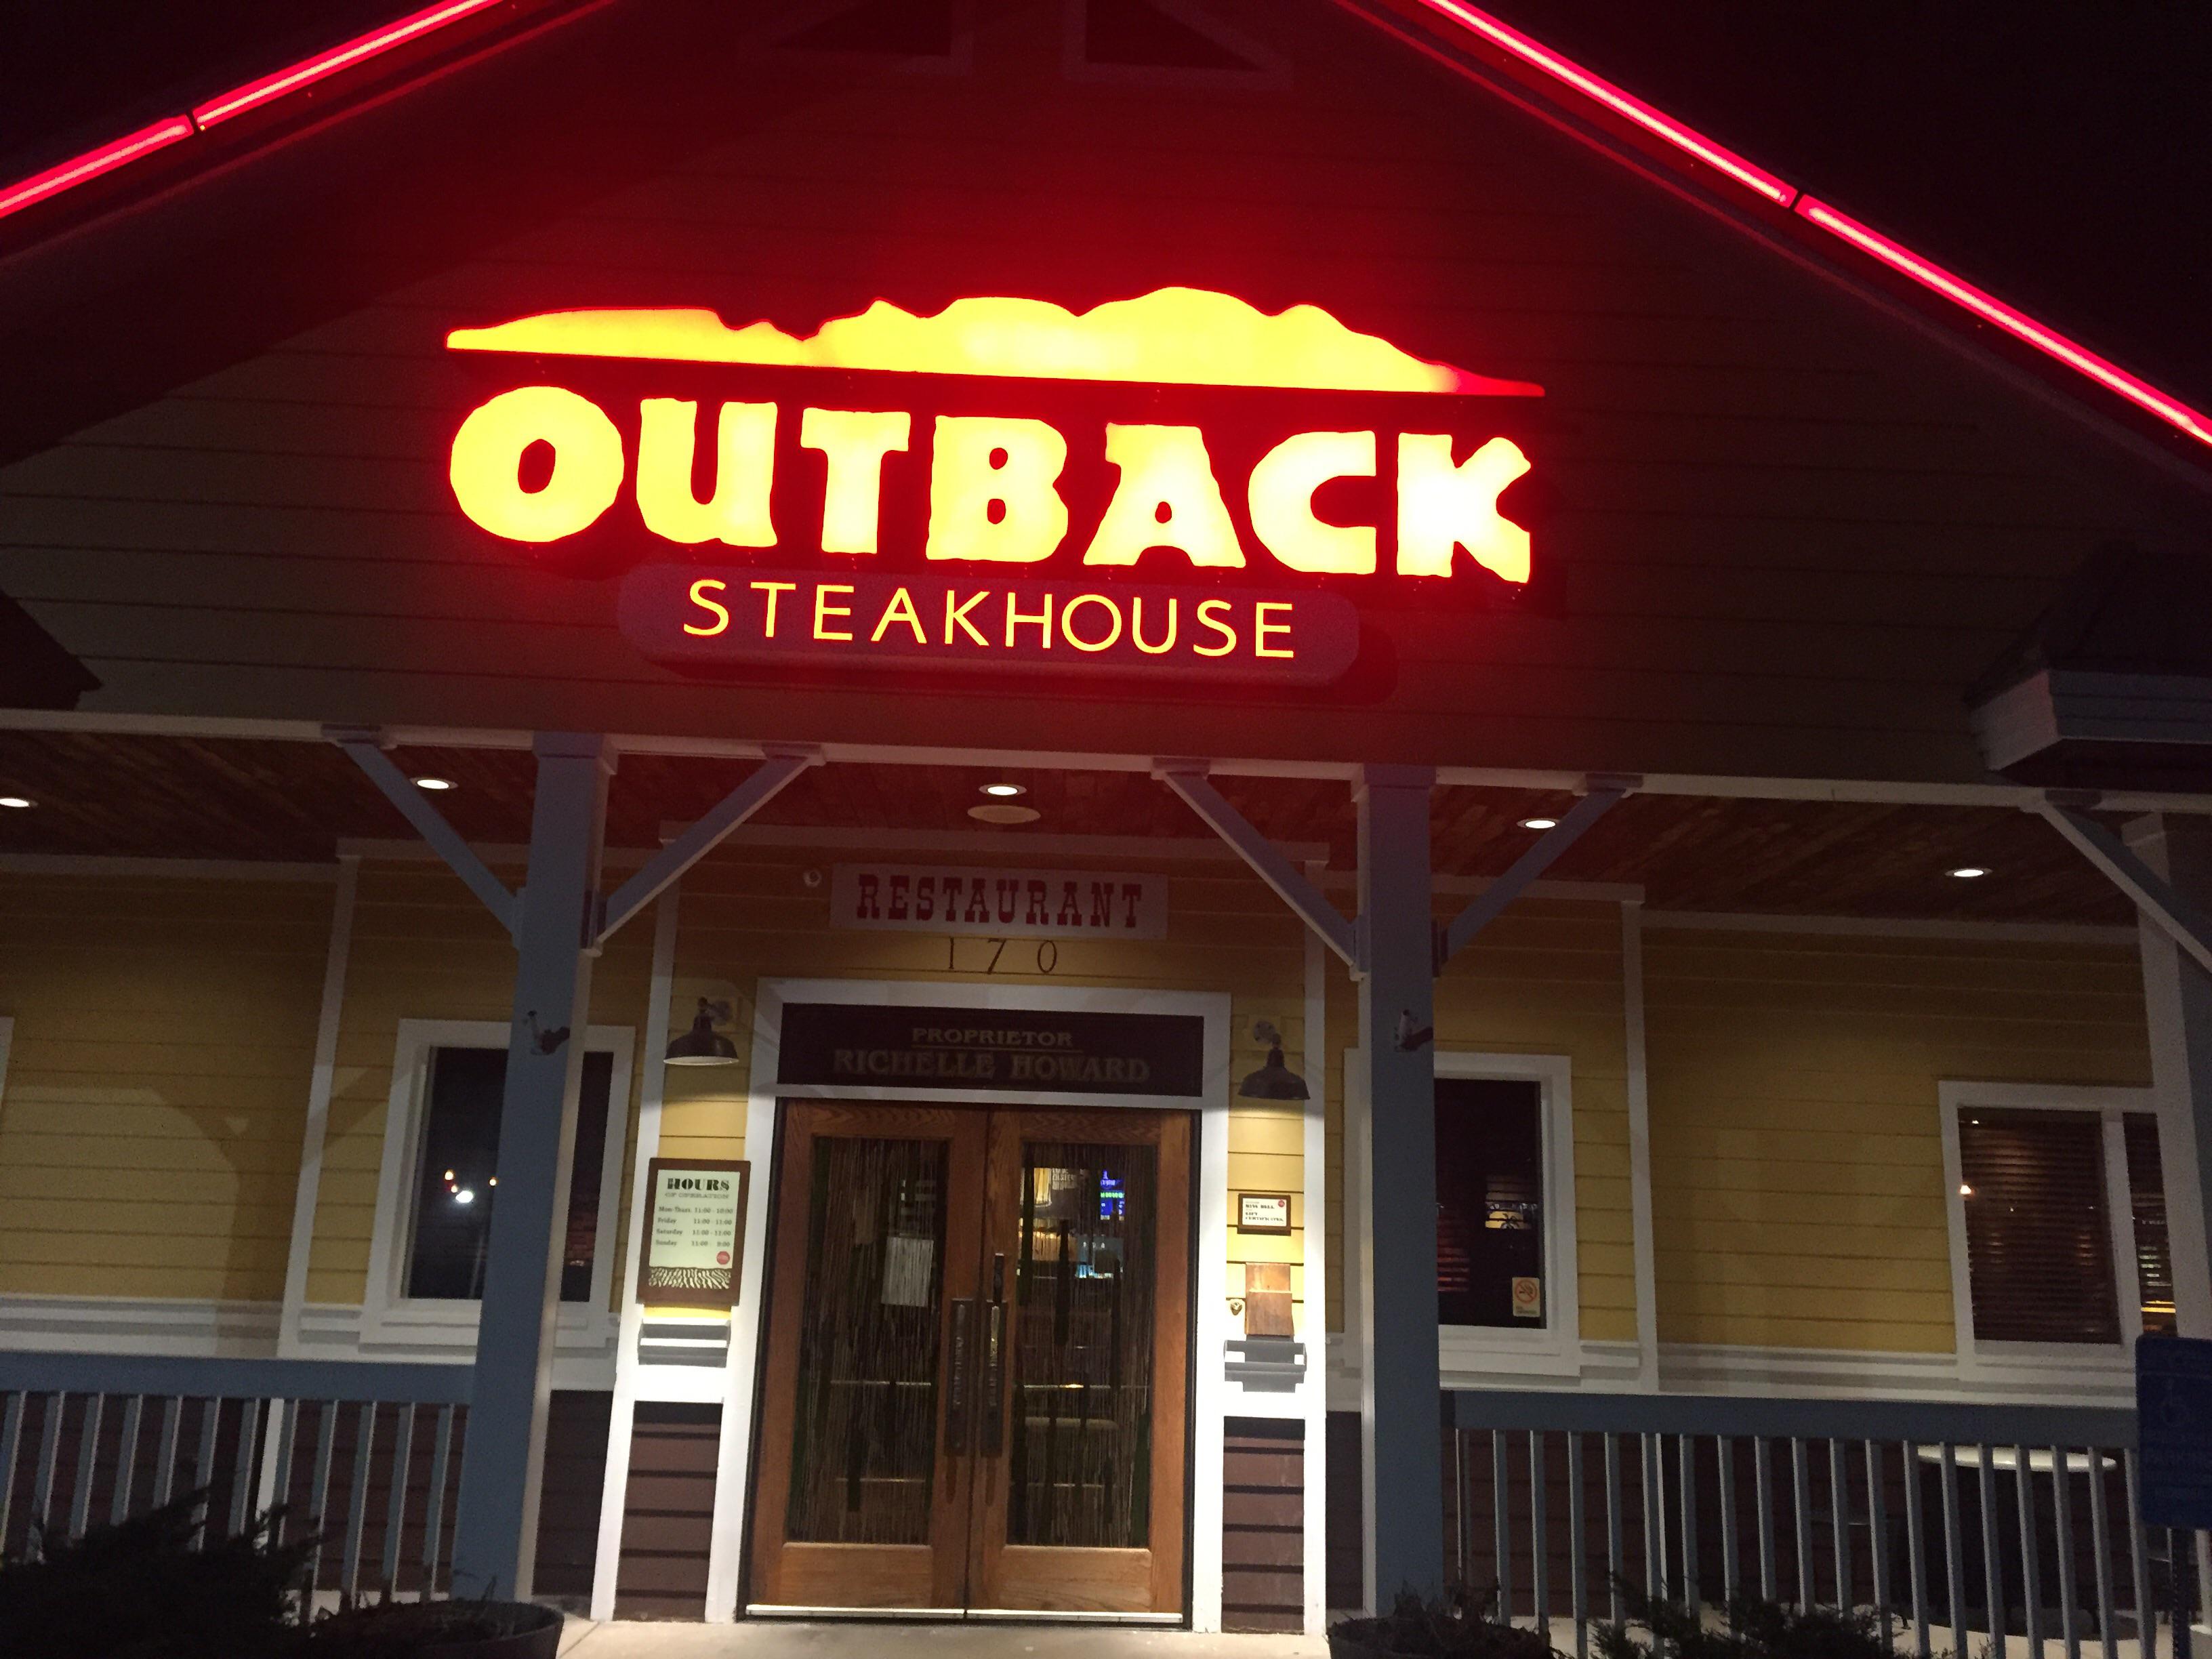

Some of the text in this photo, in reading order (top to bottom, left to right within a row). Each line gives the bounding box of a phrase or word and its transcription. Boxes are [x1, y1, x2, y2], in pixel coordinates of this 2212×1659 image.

[448, 384, 1533, 584] OUTBACK
[682, 578, 1296, 660] STEAKHOUSE
[857, 874, 1143, 928] RESTAURANT
[949, 937, 1057, 975] 170
[912, 1027, 1073, 1047] PROPRIETOR
[834, 1048, 1150, 1082] RICHELLE HOWARD
[667, 1178, 730, 1191] HOURS
